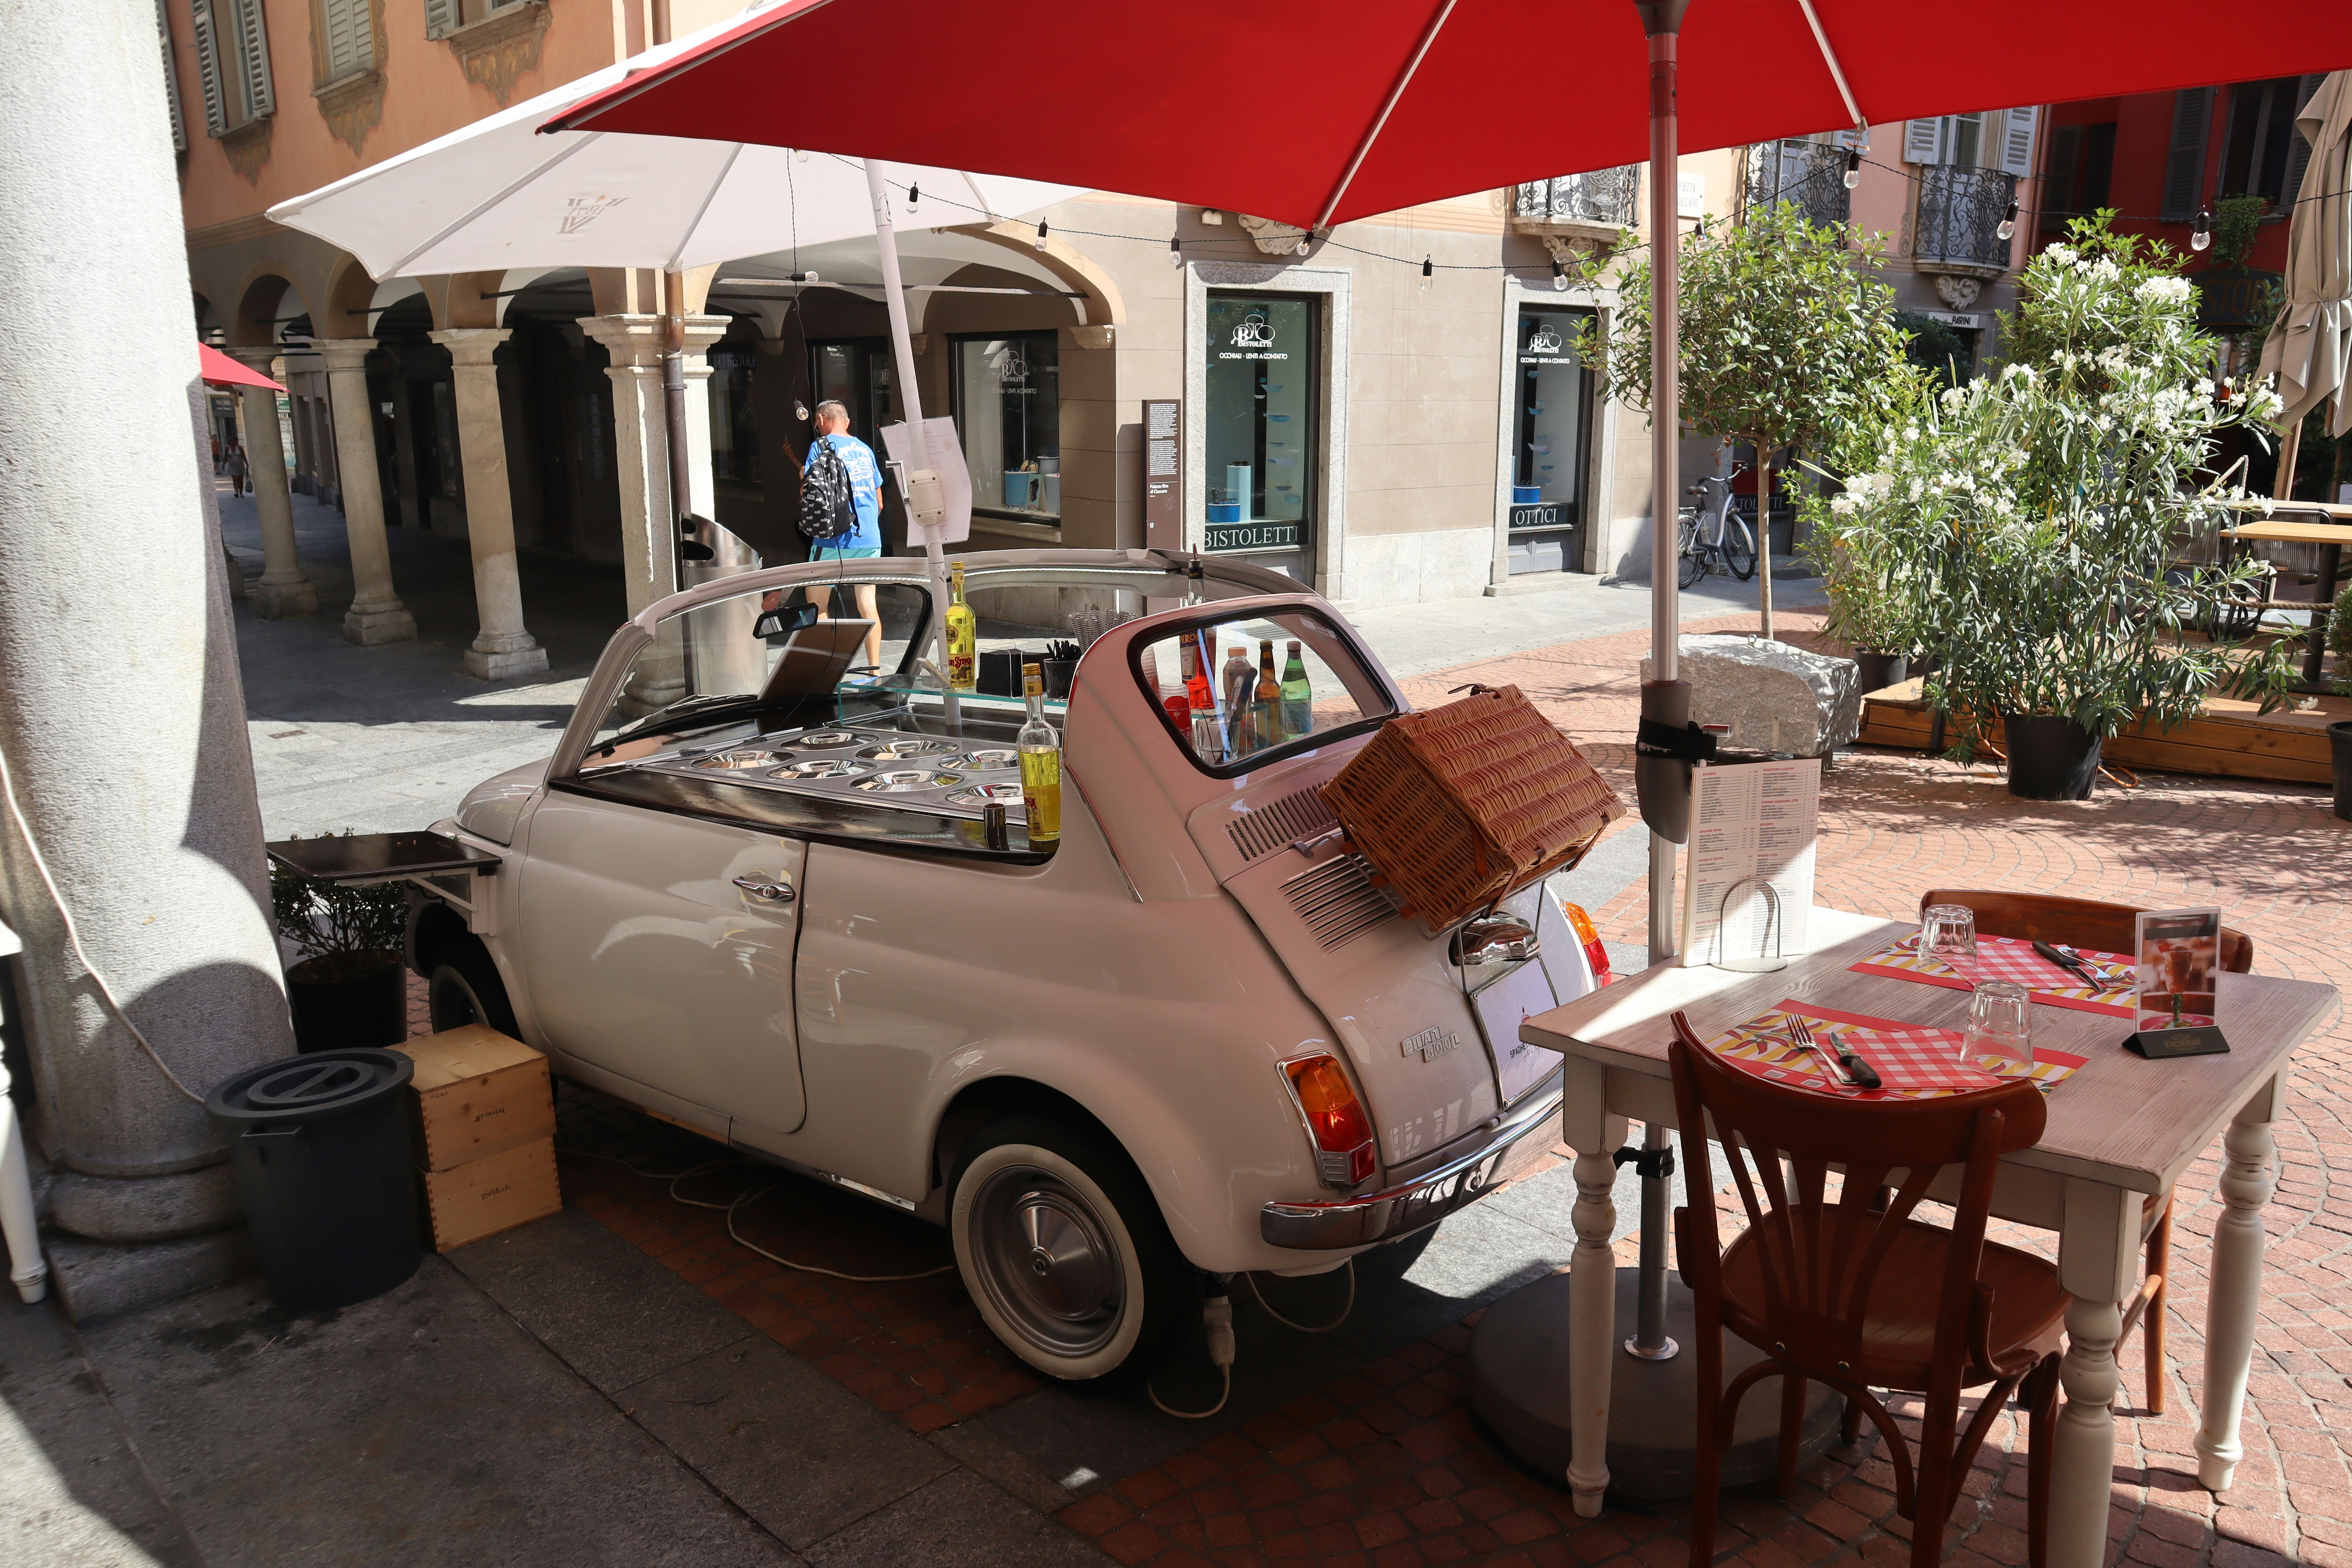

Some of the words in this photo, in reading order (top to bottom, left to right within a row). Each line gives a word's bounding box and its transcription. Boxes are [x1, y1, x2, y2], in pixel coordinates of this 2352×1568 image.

[1679, 181, 1695, 193] PIAZZA
[1679, 197, 1698, 208] OCCARO
[1952, 316, 1971, 325] PARINI
[727, 355, 755, 367] BISTOL
[1515, 508, 1557, 526] OTTICI
[1205, 525, 1298, 548] BISTOLETTI
[1180, 633, 1200, 644] PERO
[1404, 1029, 1439, 1053] FIAT
[1426, 1035, 1460, 1058] 500L
[2164, 1039, 2201, 1048] EICHHOF
[1510, 1042, 1532, 1058] SPAGHET
[475, 1107, 505, 1122] brivio.ch
[481, 1184, 510, 1200] gialdi.ch
